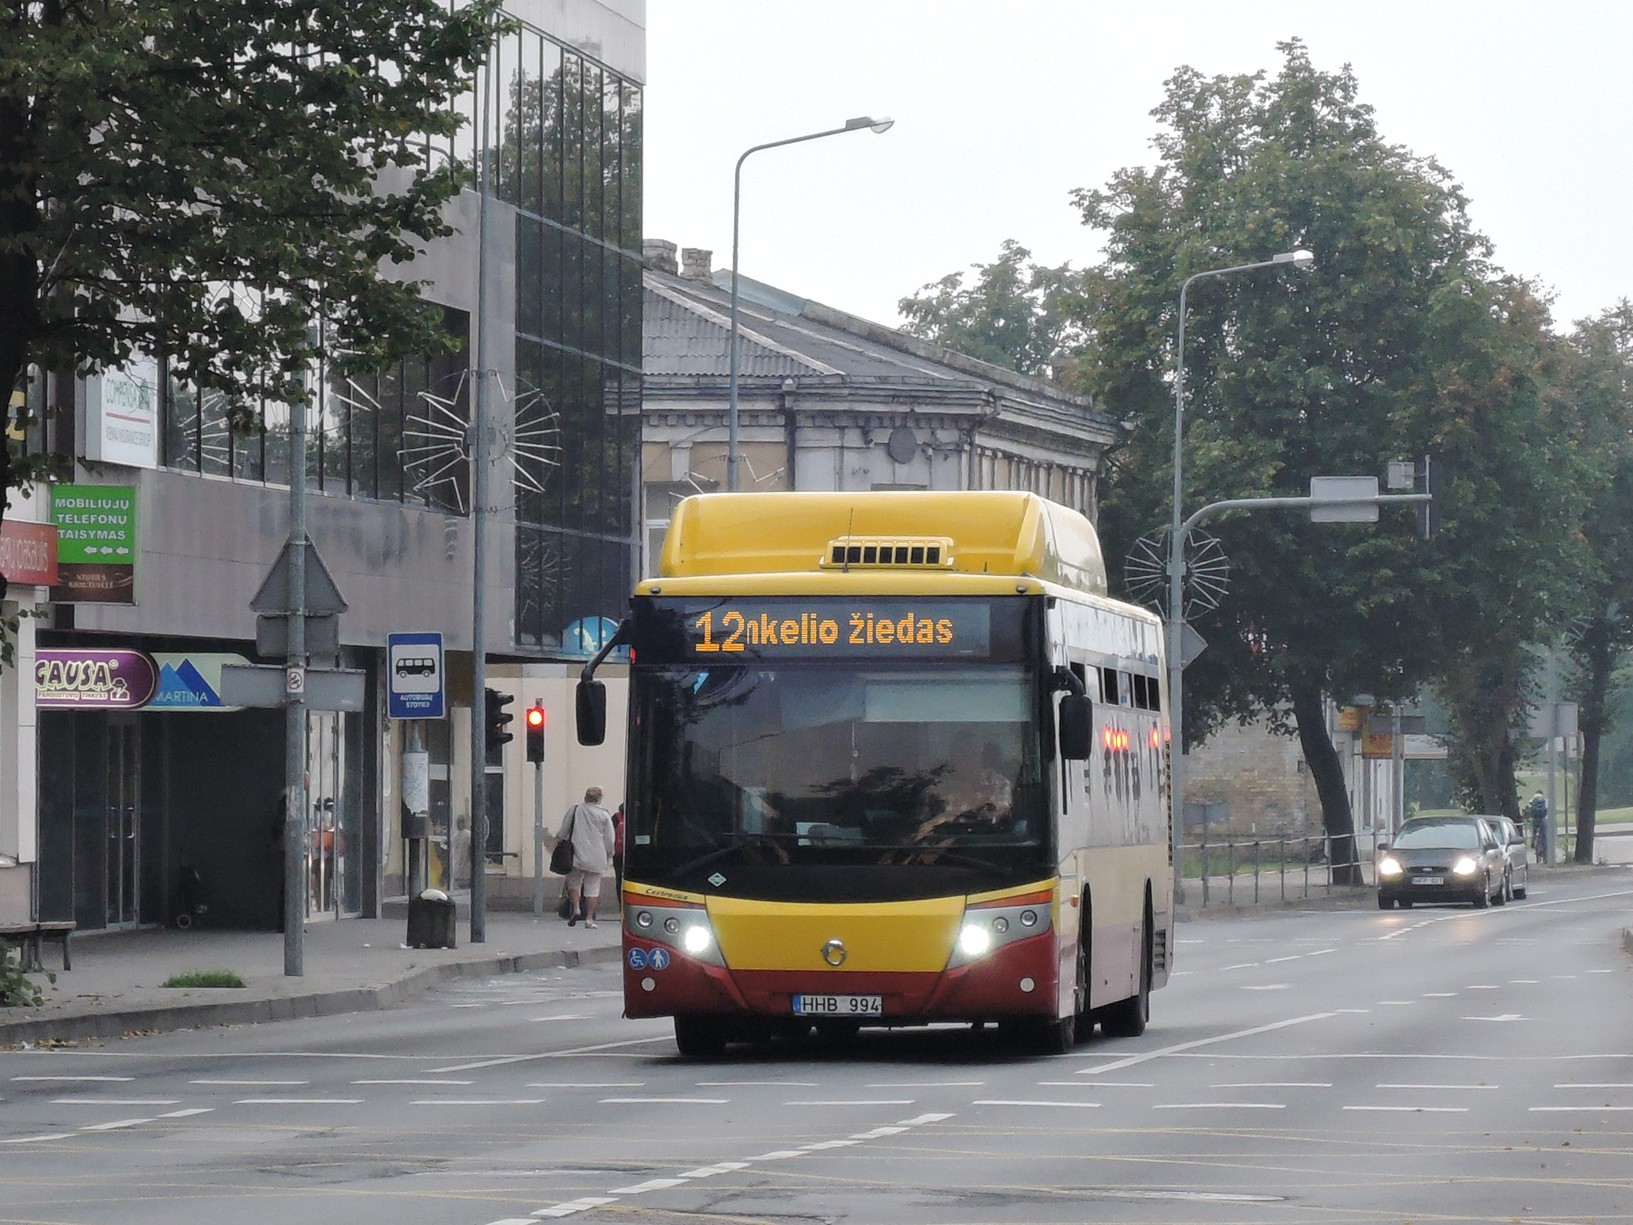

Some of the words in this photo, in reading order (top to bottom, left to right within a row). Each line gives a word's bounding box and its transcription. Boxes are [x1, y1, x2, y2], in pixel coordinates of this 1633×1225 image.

[55, 498, 130, 510] MOBILIŲJŲ
[57, 514, 128, 526] TELEFONŲ
[57, 529, 126, 540] TAISYMAS
[849, 612, 953, 644] žiedas
[35, 660, 112, 691] GAUSA
[154, 690, 208, 702] MARTINA
[802, 997, 838, 1012] HHB
[849, 997, 879, 1012] 994
